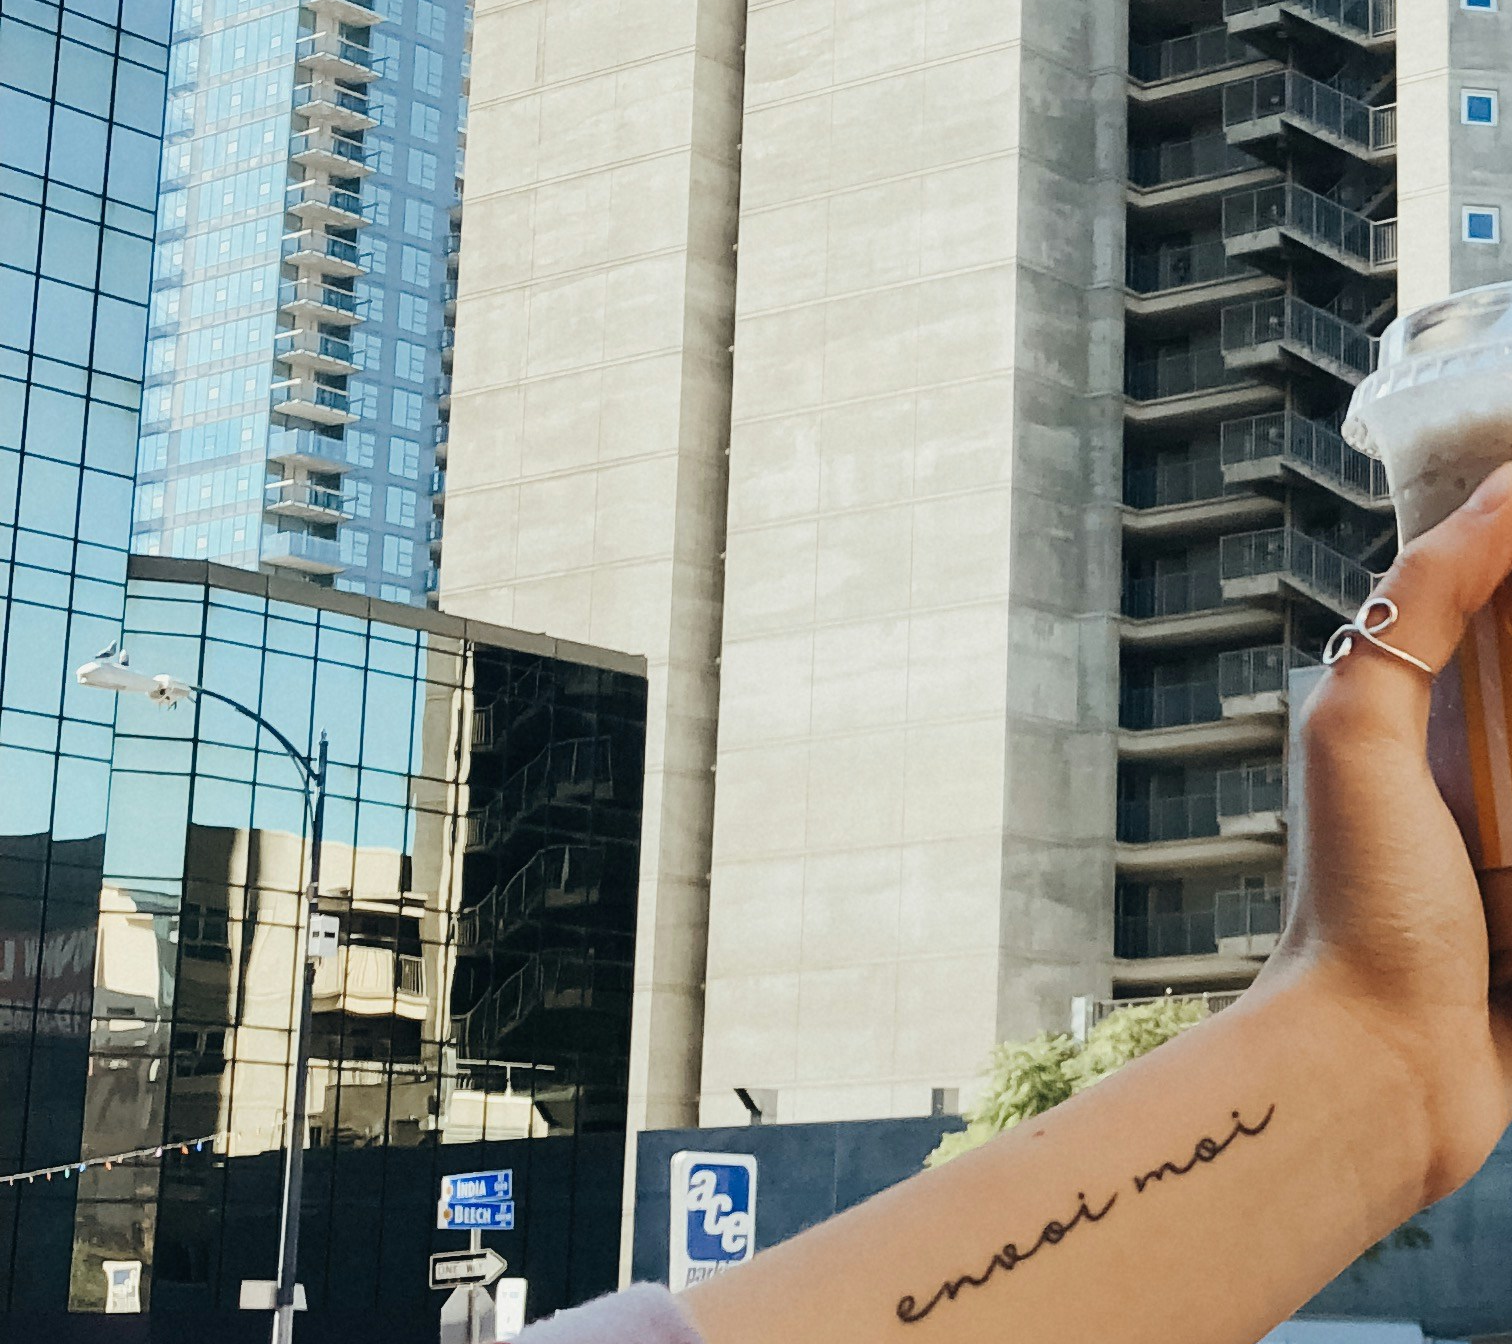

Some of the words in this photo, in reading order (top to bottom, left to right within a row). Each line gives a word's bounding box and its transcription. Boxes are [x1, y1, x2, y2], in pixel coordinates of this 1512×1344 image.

[456, 1179, 487, 1199] INDIA
[1134, 1103, 1276, 1194] moi
[687, 1169, 752, 1253] ace
